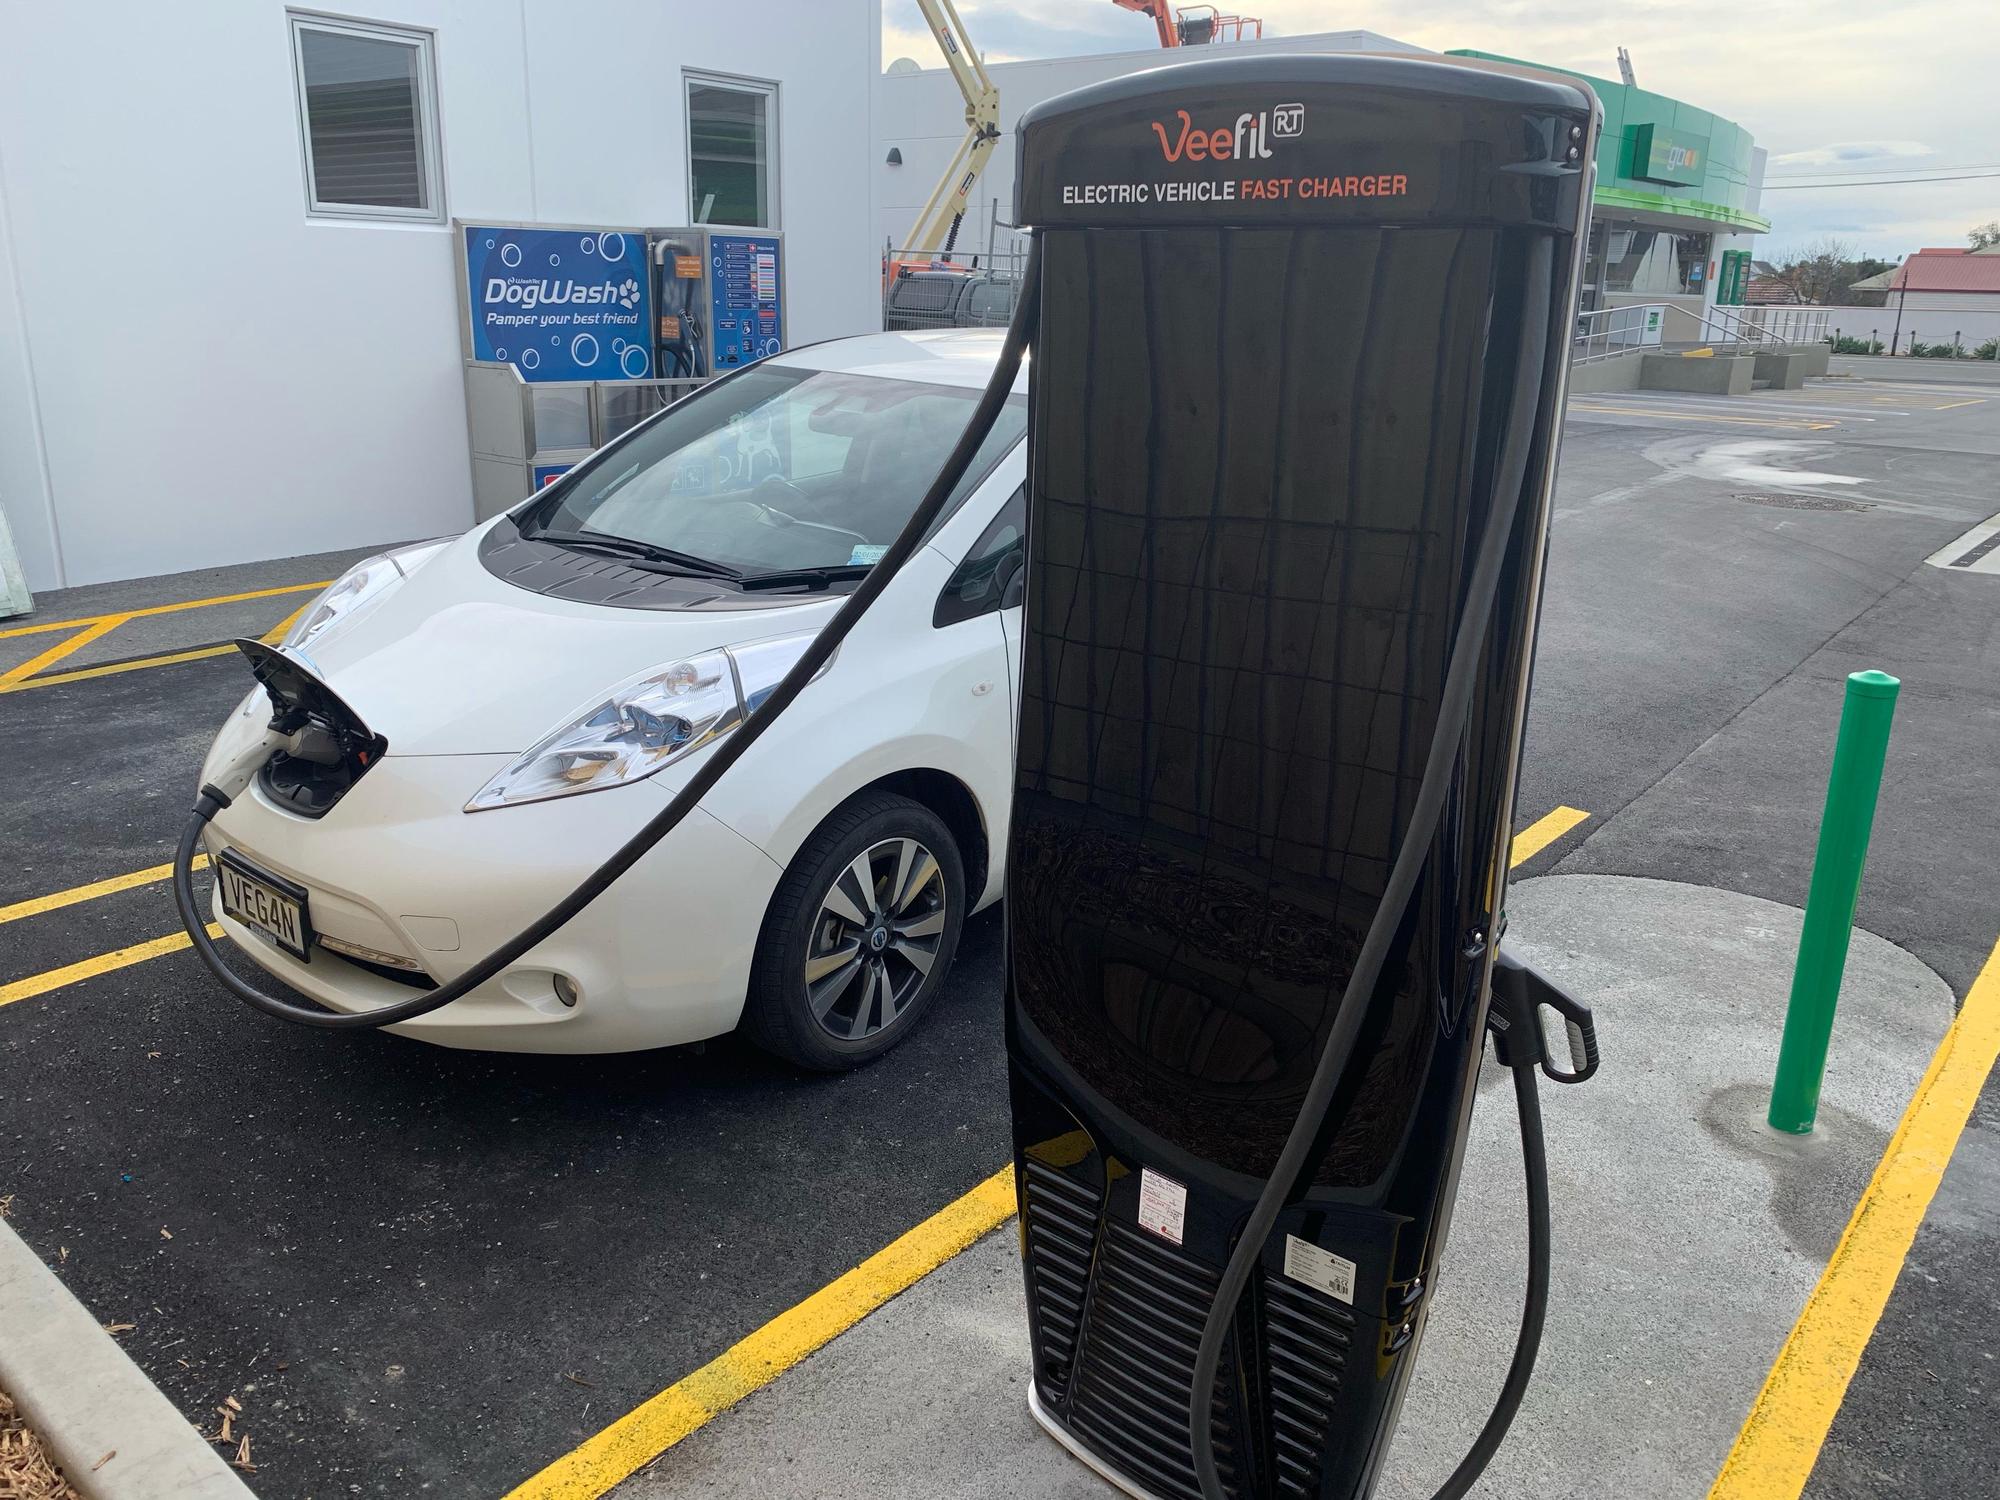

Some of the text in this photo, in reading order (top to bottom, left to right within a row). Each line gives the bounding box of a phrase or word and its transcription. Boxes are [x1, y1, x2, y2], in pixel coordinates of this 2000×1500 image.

[1152, 105, 1303, 162] Veefil RT
[1063, 175, 1408, 205] ELECTRIC VEHICLE FAST CHARGER
[485, 278, 618, 309] DogWash
[486, 313, 639, 327] Pamper your best friend
[229, 873, 296, 943] VEG4N
